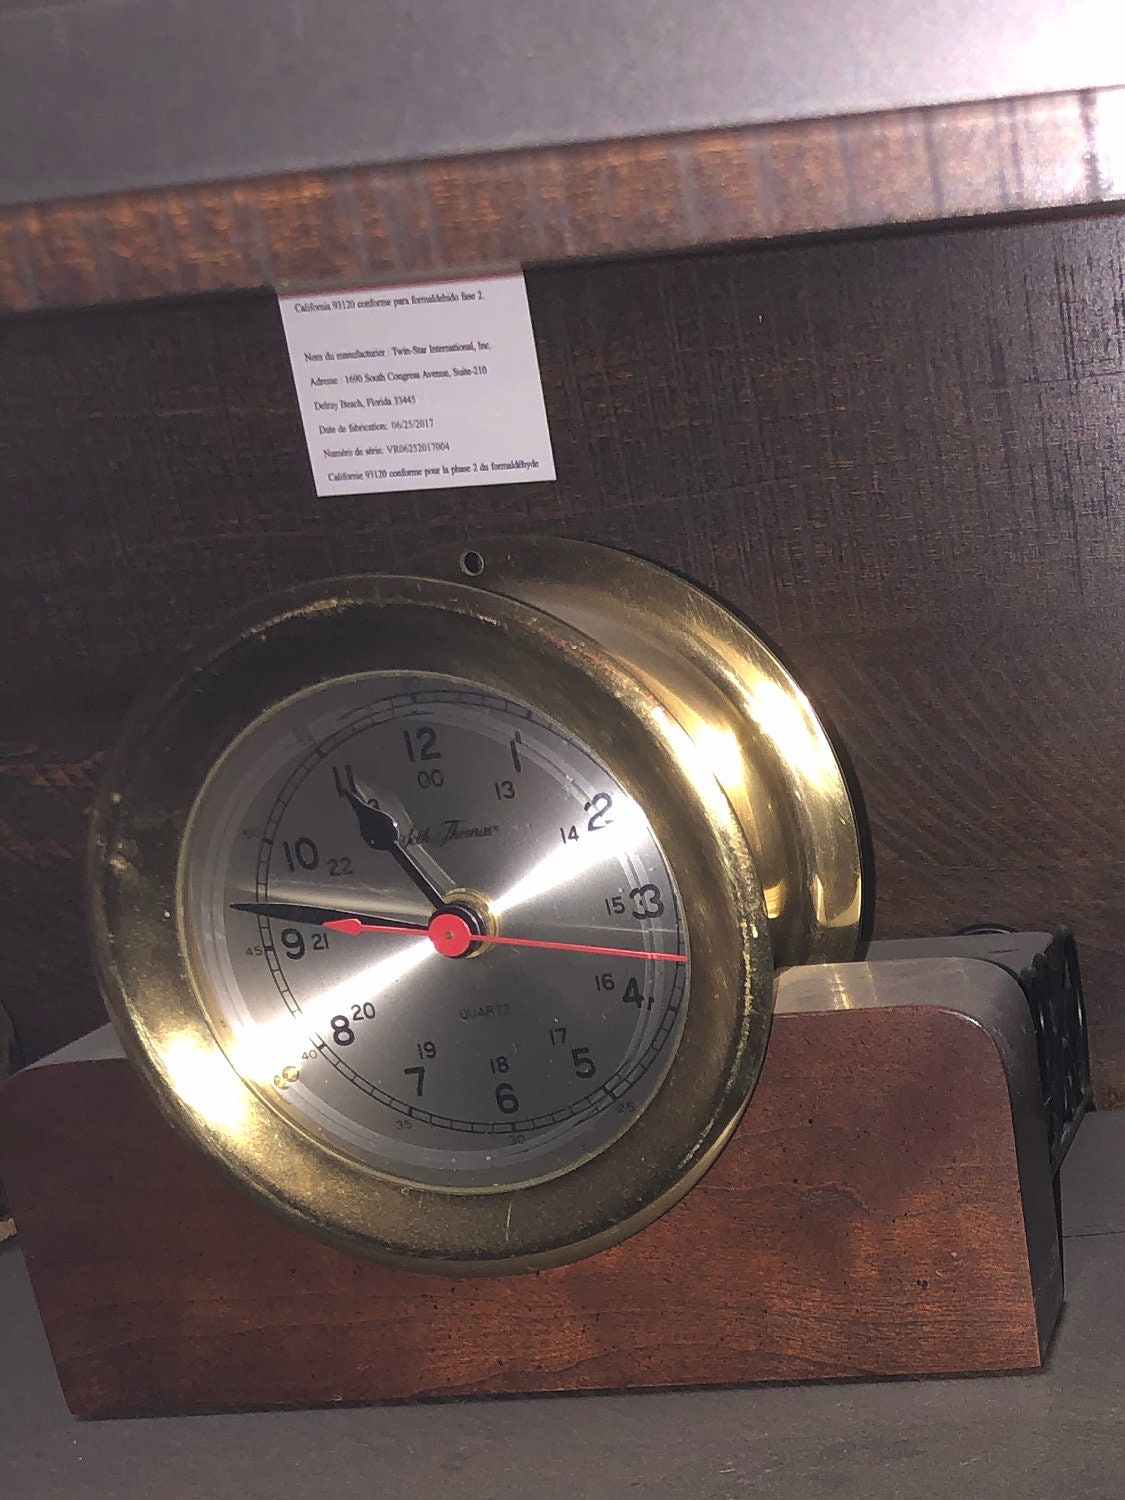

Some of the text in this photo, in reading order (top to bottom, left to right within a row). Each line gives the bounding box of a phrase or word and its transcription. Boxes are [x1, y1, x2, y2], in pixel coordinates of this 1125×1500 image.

[294, 301, 331, 313] California
[332, 300, 355, 310] 93120
[357, 298, 391, 308] conforme
[394, 297, 409, 308] para
[304, 352, 323, 362] Nom
[391, 345, 426, 356] Twin-Star
[429, 341, 476, 353] International,
[365, 372, 386, 383] South
[388, 371, 421, 382] Congress
[314, 395, 416, 412] Delray Beach, Florida 33445
[319, 424, 336, 435] Date
[338, 424, 346, 433] de
[391, 418, 434, 430] 06/25/2017
[355, 447, 363, 456] de
[365, 469, 387, 479] 93120
[389, 467, 422, 478] conforme
[424, 467, 442, 478] pour
[442, 465, 449, 475] la
[451, 464, 471, 476] phase
[472, 462, 478, 472] 2
[480, 462, 489, 472] du
[402, 726, 442, 763] 12
[417, 768, 445, 790] 00
[494, 780, 516, 800] 13
[583, 792, 614, 832] 2
[559, 825, 580, 845] 14
[283, 837, 320, 872] 10
[326, 856, 354, 877] 22
[604, 895, 626, 916] 15
[245, 946, 263, 957] 45
[281, 928, 306, 960] 9
[311, 932, 330, 951] 21
[594, 972, 615, 992] 16
[622, 976, 653, 1011] 4
[350, 1001, 376, 1022] 20
[330, 1014, 356, 1047] 8
[549, 1027, 567, 1046] 17
[301, 1049, 319, 1061] 40
[417, 1040, 437, 1060] 19
[489, 1055, 510, 1075] 18
[571, 1047, 597, 1080] 5
[404, 1066, 426, 1097] 7
[494, 1082, 520, 1115] 6
